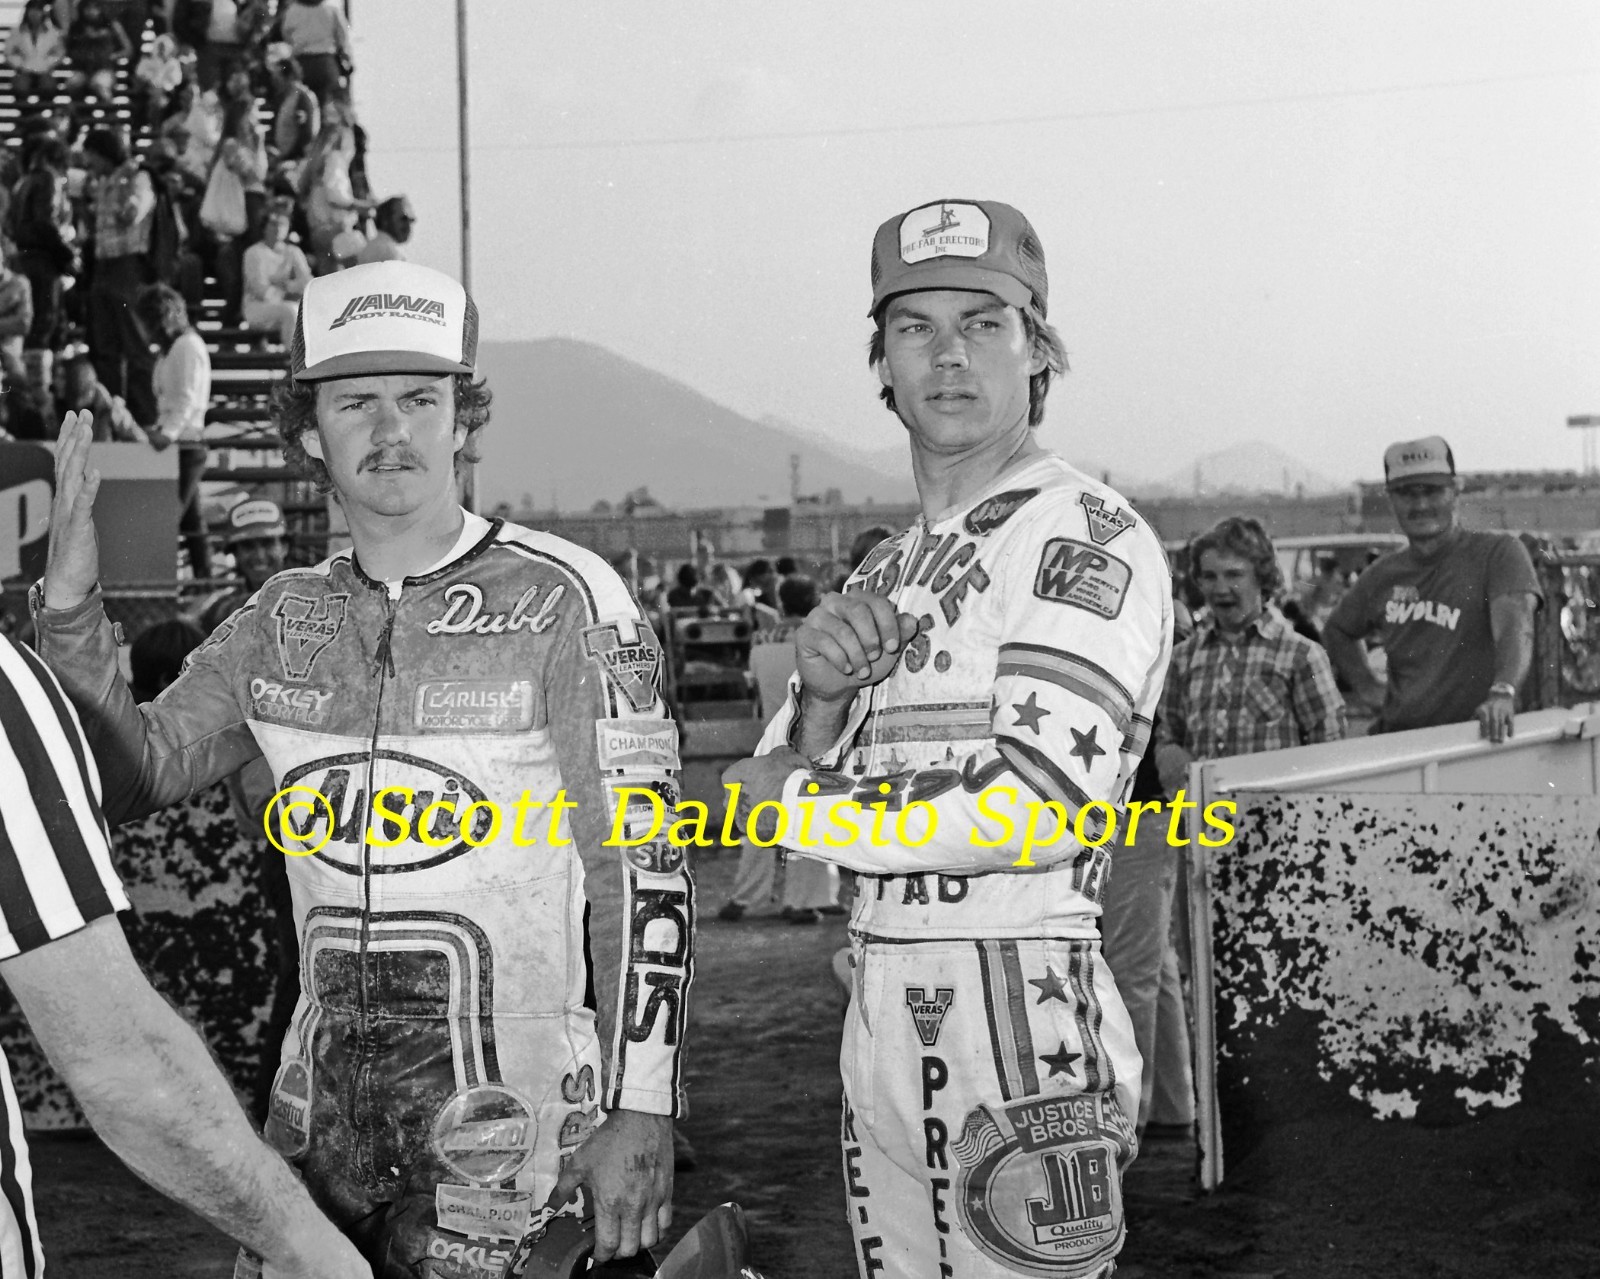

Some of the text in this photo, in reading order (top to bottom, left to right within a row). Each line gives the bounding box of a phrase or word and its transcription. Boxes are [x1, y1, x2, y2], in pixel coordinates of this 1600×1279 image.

[329, 294, 444, 331] JAWA
[427, 583, 565, 635] Dubb
[251, 678, 334, 711] OAKLEY
[1016, 1100, 1095, 1128] JUSTICE
[1031, 1118, 1093, 1144] BROS.
[1050, 1218, 1104, 1238] Quality
[1054, 1235, 1104, 1252] PRODUCTS
